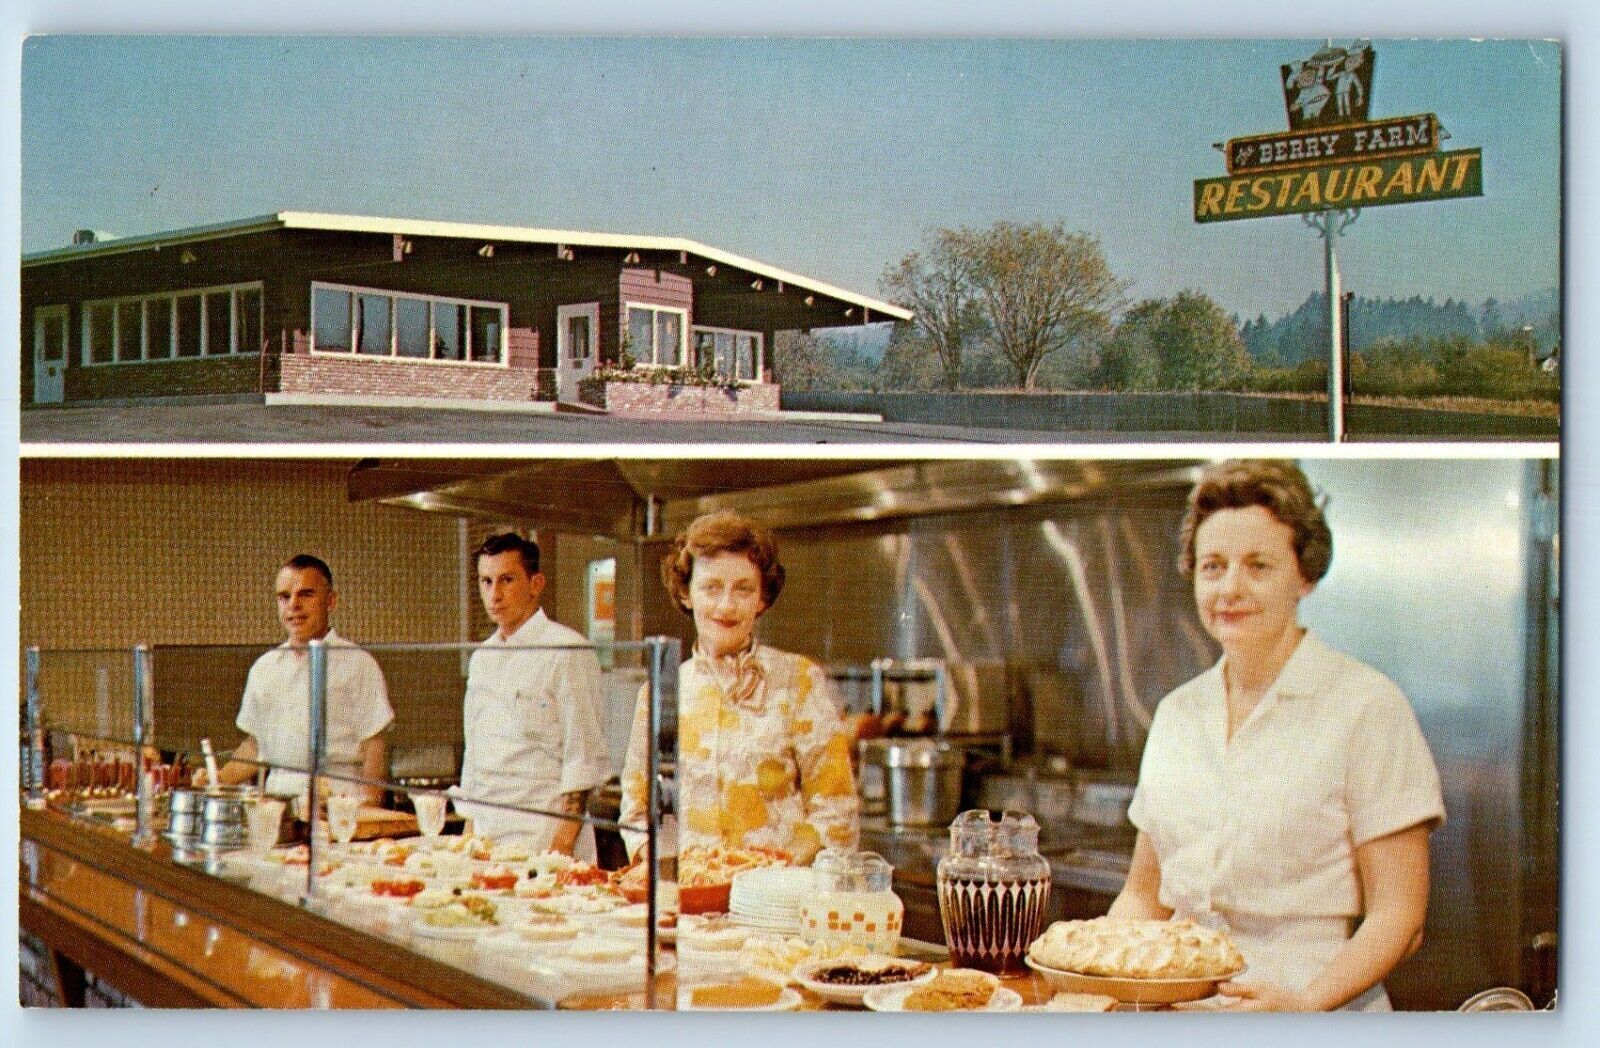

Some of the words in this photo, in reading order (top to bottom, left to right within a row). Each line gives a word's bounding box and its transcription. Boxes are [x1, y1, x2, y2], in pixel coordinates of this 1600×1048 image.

[1259, 134, 1339, 163] BERRY
[1354, 119, 1430, 151] FARM
[1198, 153, 1479, 216] RESTAURANT
